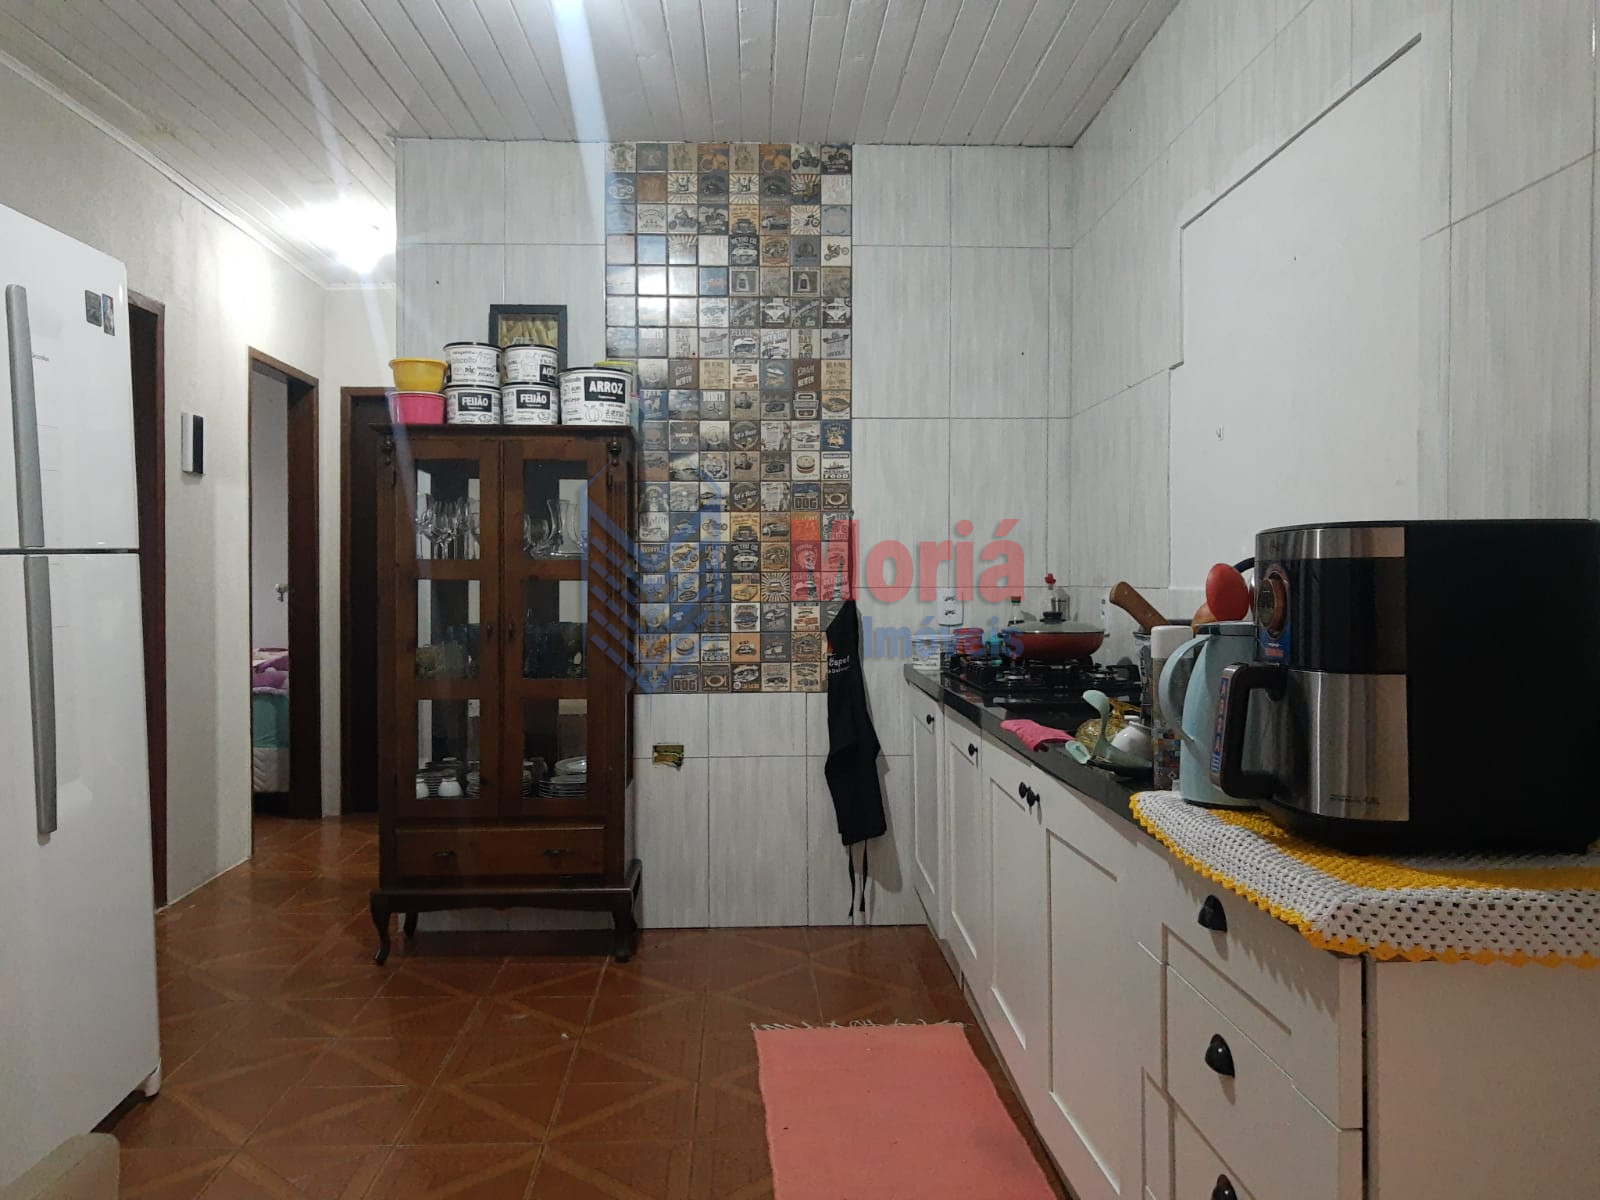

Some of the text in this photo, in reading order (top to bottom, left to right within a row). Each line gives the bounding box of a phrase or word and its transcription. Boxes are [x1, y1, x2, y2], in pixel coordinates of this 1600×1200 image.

[589, 380, 623, 395] ARROZ
[462, 395, 489, 406] FEIJÃO
[520, 392, 547, 404] FEIJÃO
